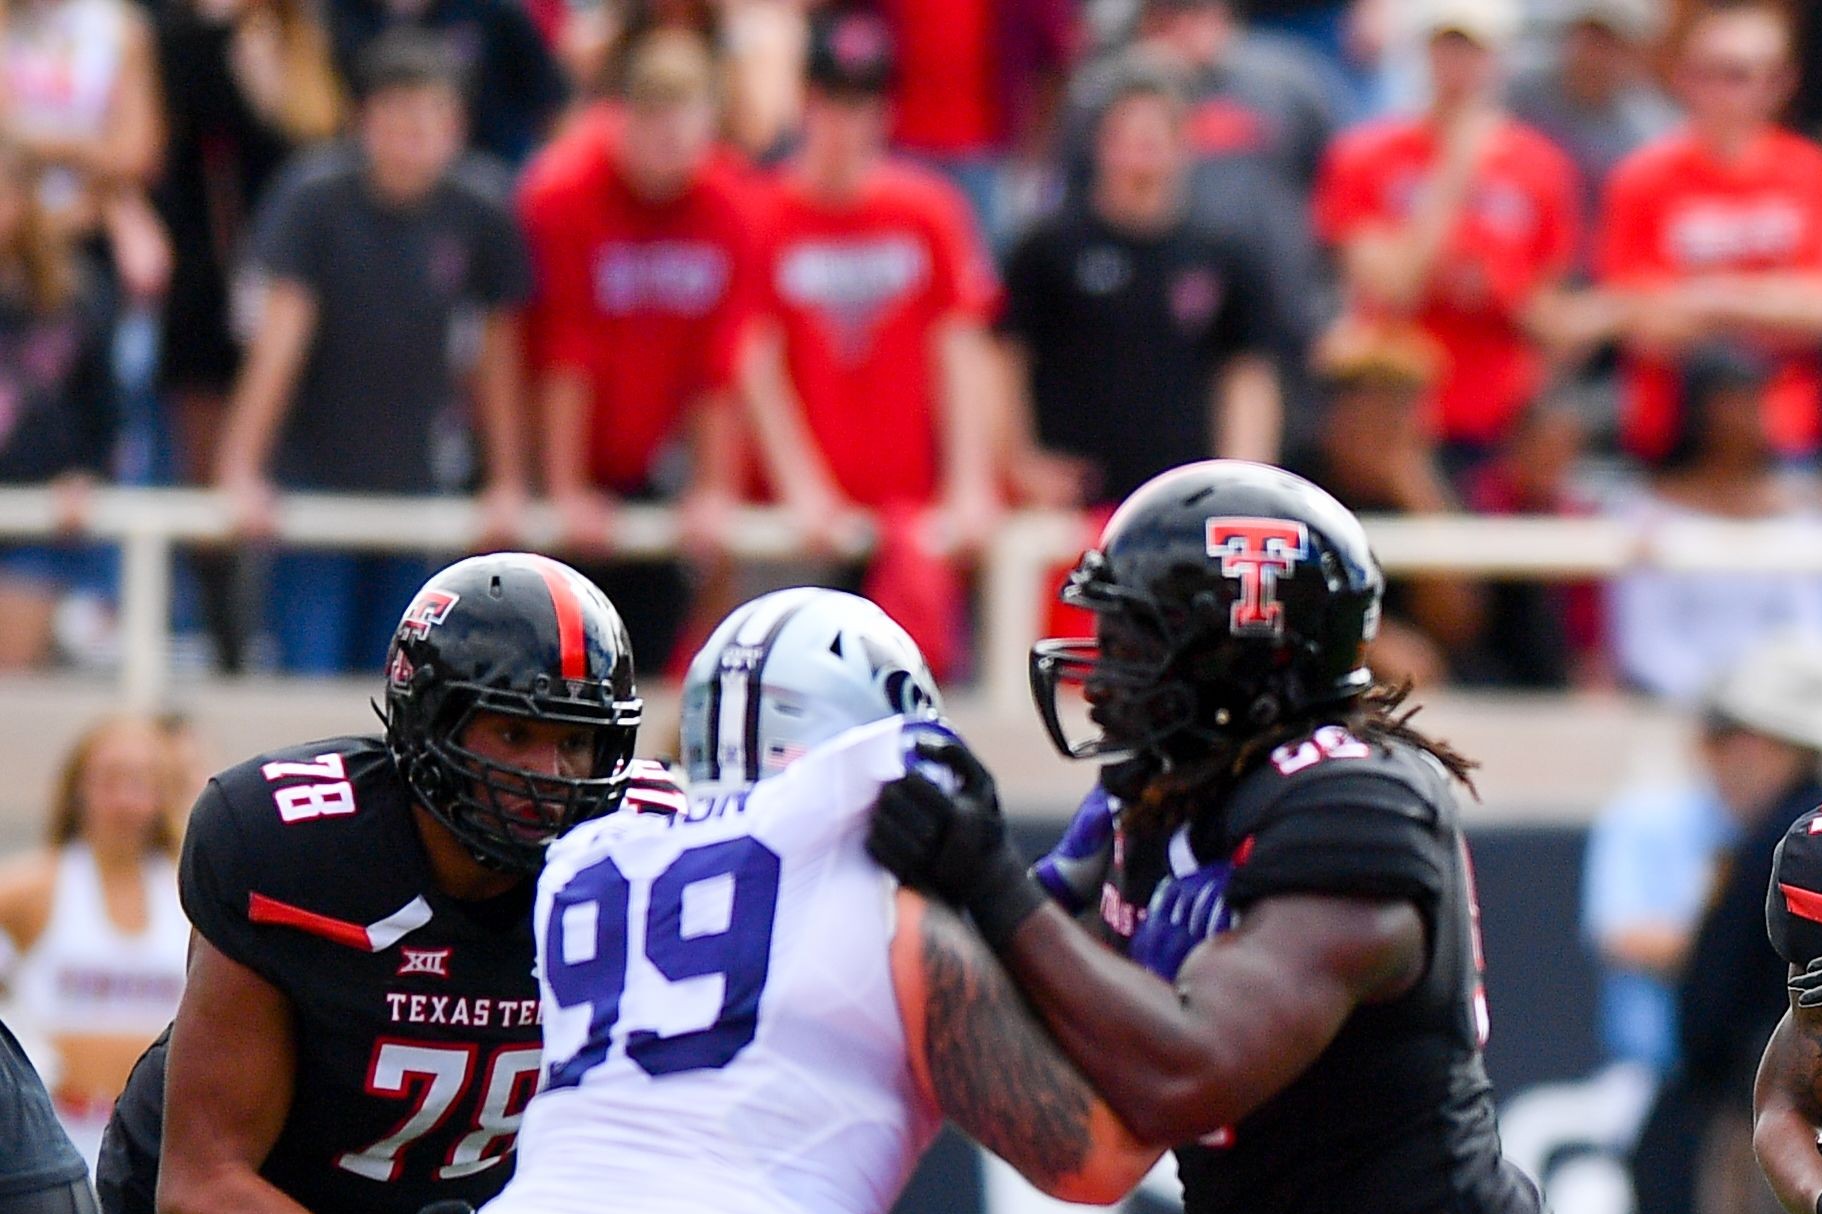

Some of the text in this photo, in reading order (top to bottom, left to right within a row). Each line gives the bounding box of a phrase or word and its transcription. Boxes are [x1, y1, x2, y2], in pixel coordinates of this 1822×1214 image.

[259, 752, 358, 824] 78
[396, 947, 453, 978] XII
[543, 834, 782, 1092] 99
[386, 992, 546, 1028] TEXAS TE
[332, 1036, 546, 1183] 78
